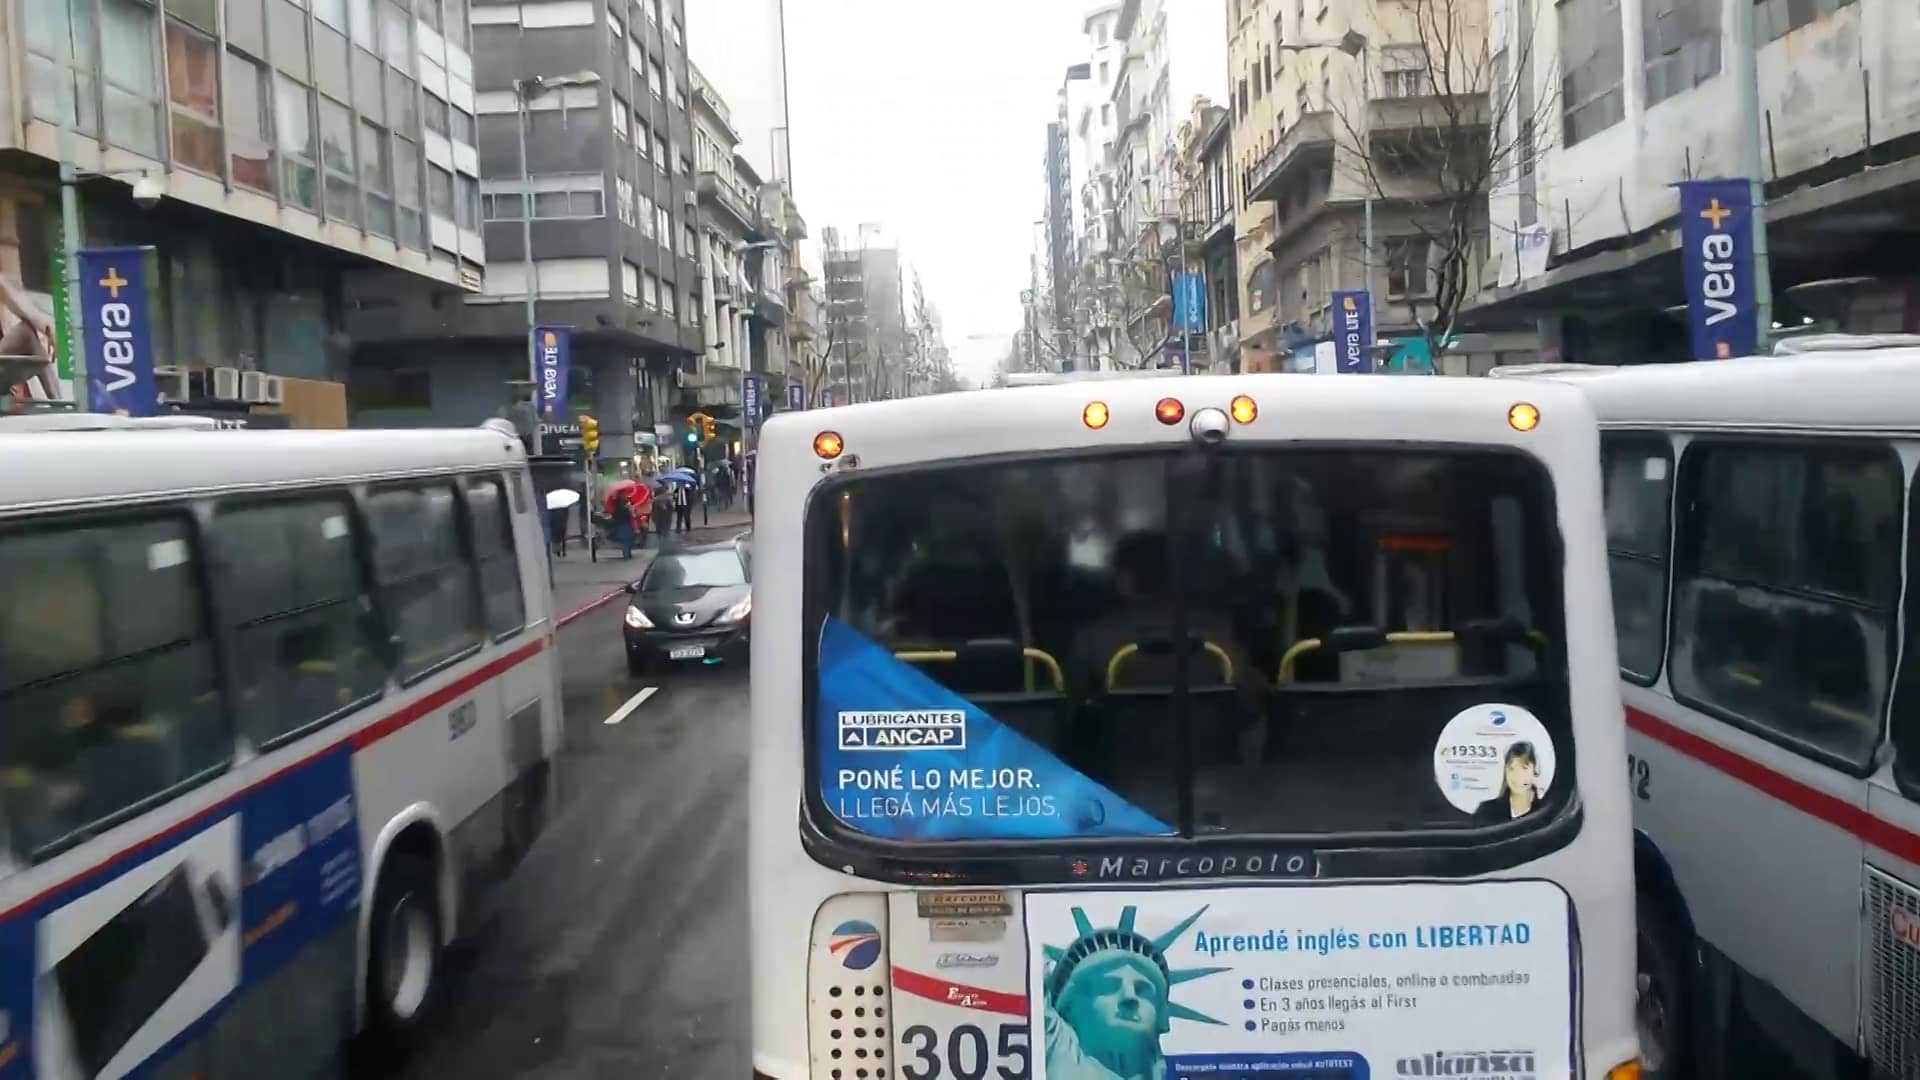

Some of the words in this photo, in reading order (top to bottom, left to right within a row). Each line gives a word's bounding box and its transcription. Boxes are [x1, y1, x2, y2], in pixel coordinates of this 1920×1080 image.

[841, 712, 963, 726] LUBRICANTES
[874, 728, 955, 745] ANCAP
[1451, 745, 1498, 758] 19333
[838, 764, 904, 790] PONÉ
[911, 768, 941, 790] LO
[949, 768, 1041, 790] MEJOR.
[840, 792, 915, 819] LLEGÁ
[921, 791, 973, 818] MÁS
[1099, 853, 1306, 878] Marcopolo
[1195, 929, 1289, 958] Aprendé
[1296, 927, 1360, 956] inglés
[1368, 931, 1407, 948] con
[1415, 922, 1531, 948] LIBERTAD
[1259, 976, 1304, 991] Clases
[1396, 971, 1437, 988] online
[1439, 974, 1449, 986] o
[1260, 997, 1278, 1012] En
[1282, 997, 1291, 1011] 3
[1295, 995, 1326, 1010] años
[1328, 995, 1367, 1013] llegás
[1370, 995, 1383, 1009] al
[1386, 993, 1417, 1009] First
[1304, 1018, 1346, 1032] menos
[900, 1024, 1029, 1080] 305
